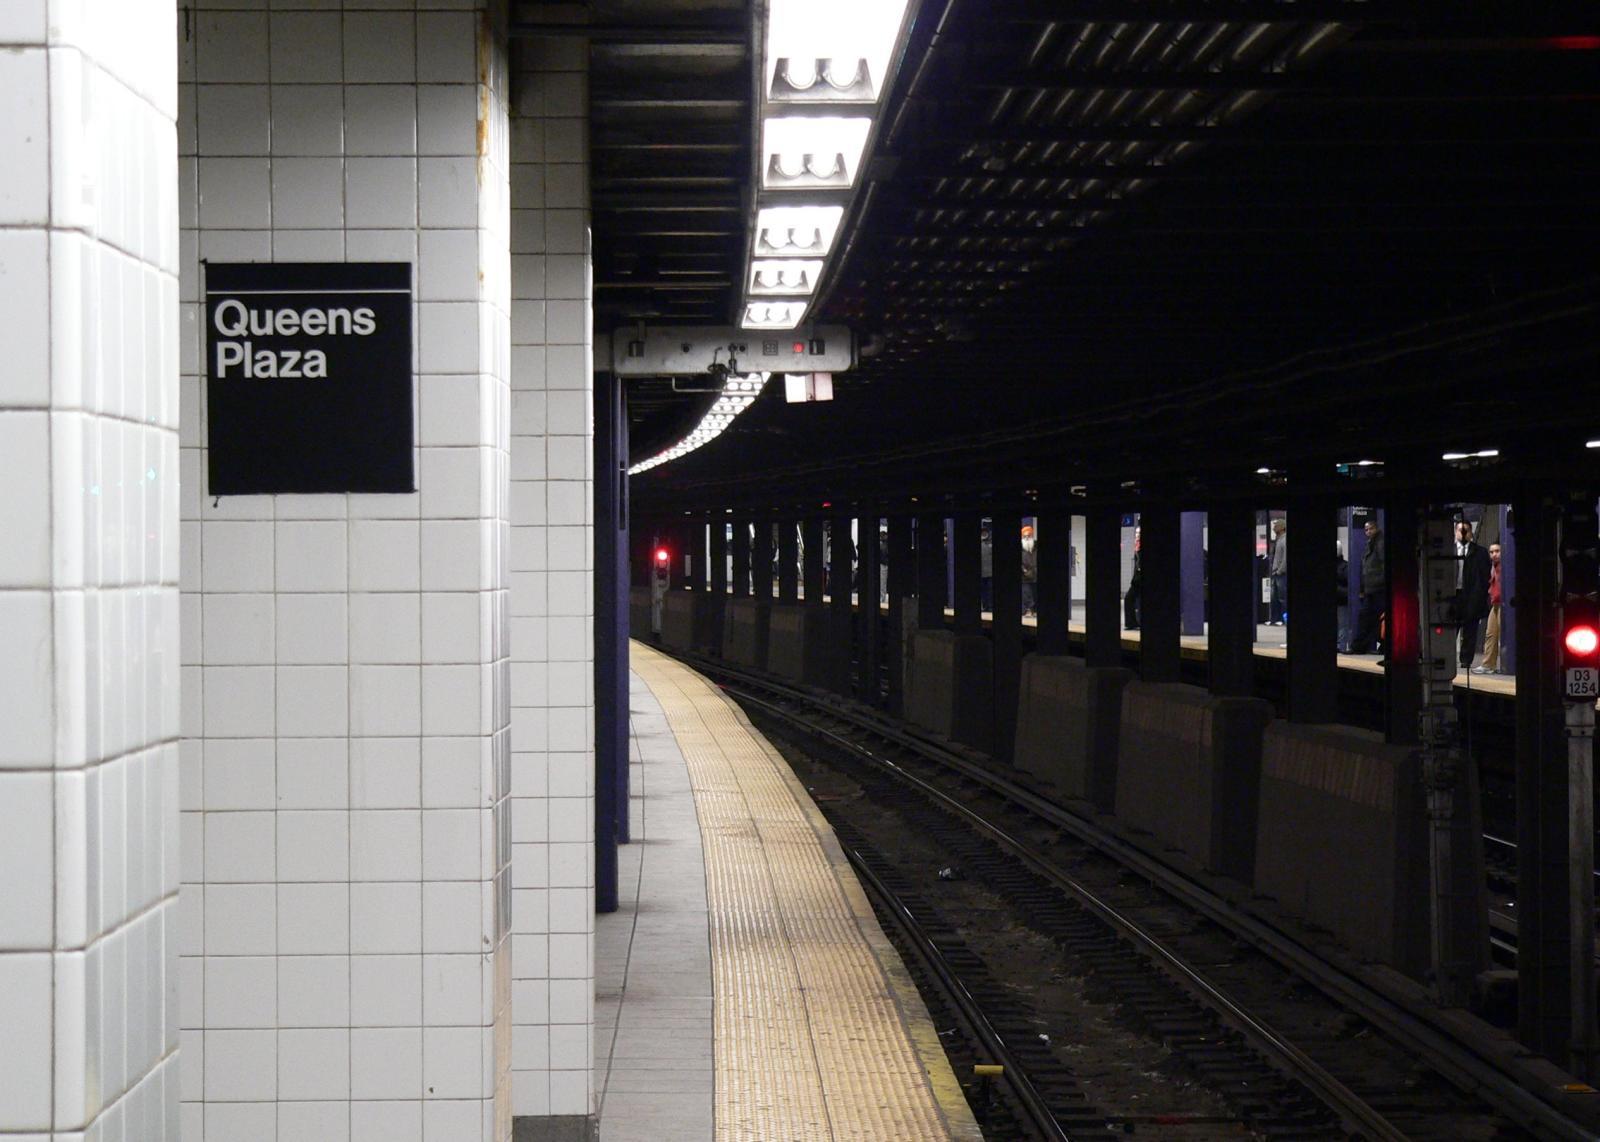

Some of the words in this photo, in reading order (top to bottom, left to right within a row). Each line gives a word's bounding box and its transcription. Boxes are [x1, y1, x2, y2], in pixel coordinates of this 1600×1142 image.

[214, 299, 376, 337] Queens
[216, 341, 328, 378] Plaza
[1574, 670, 1590, 681] D3
[1569, 682, 1596, 694] 1254
